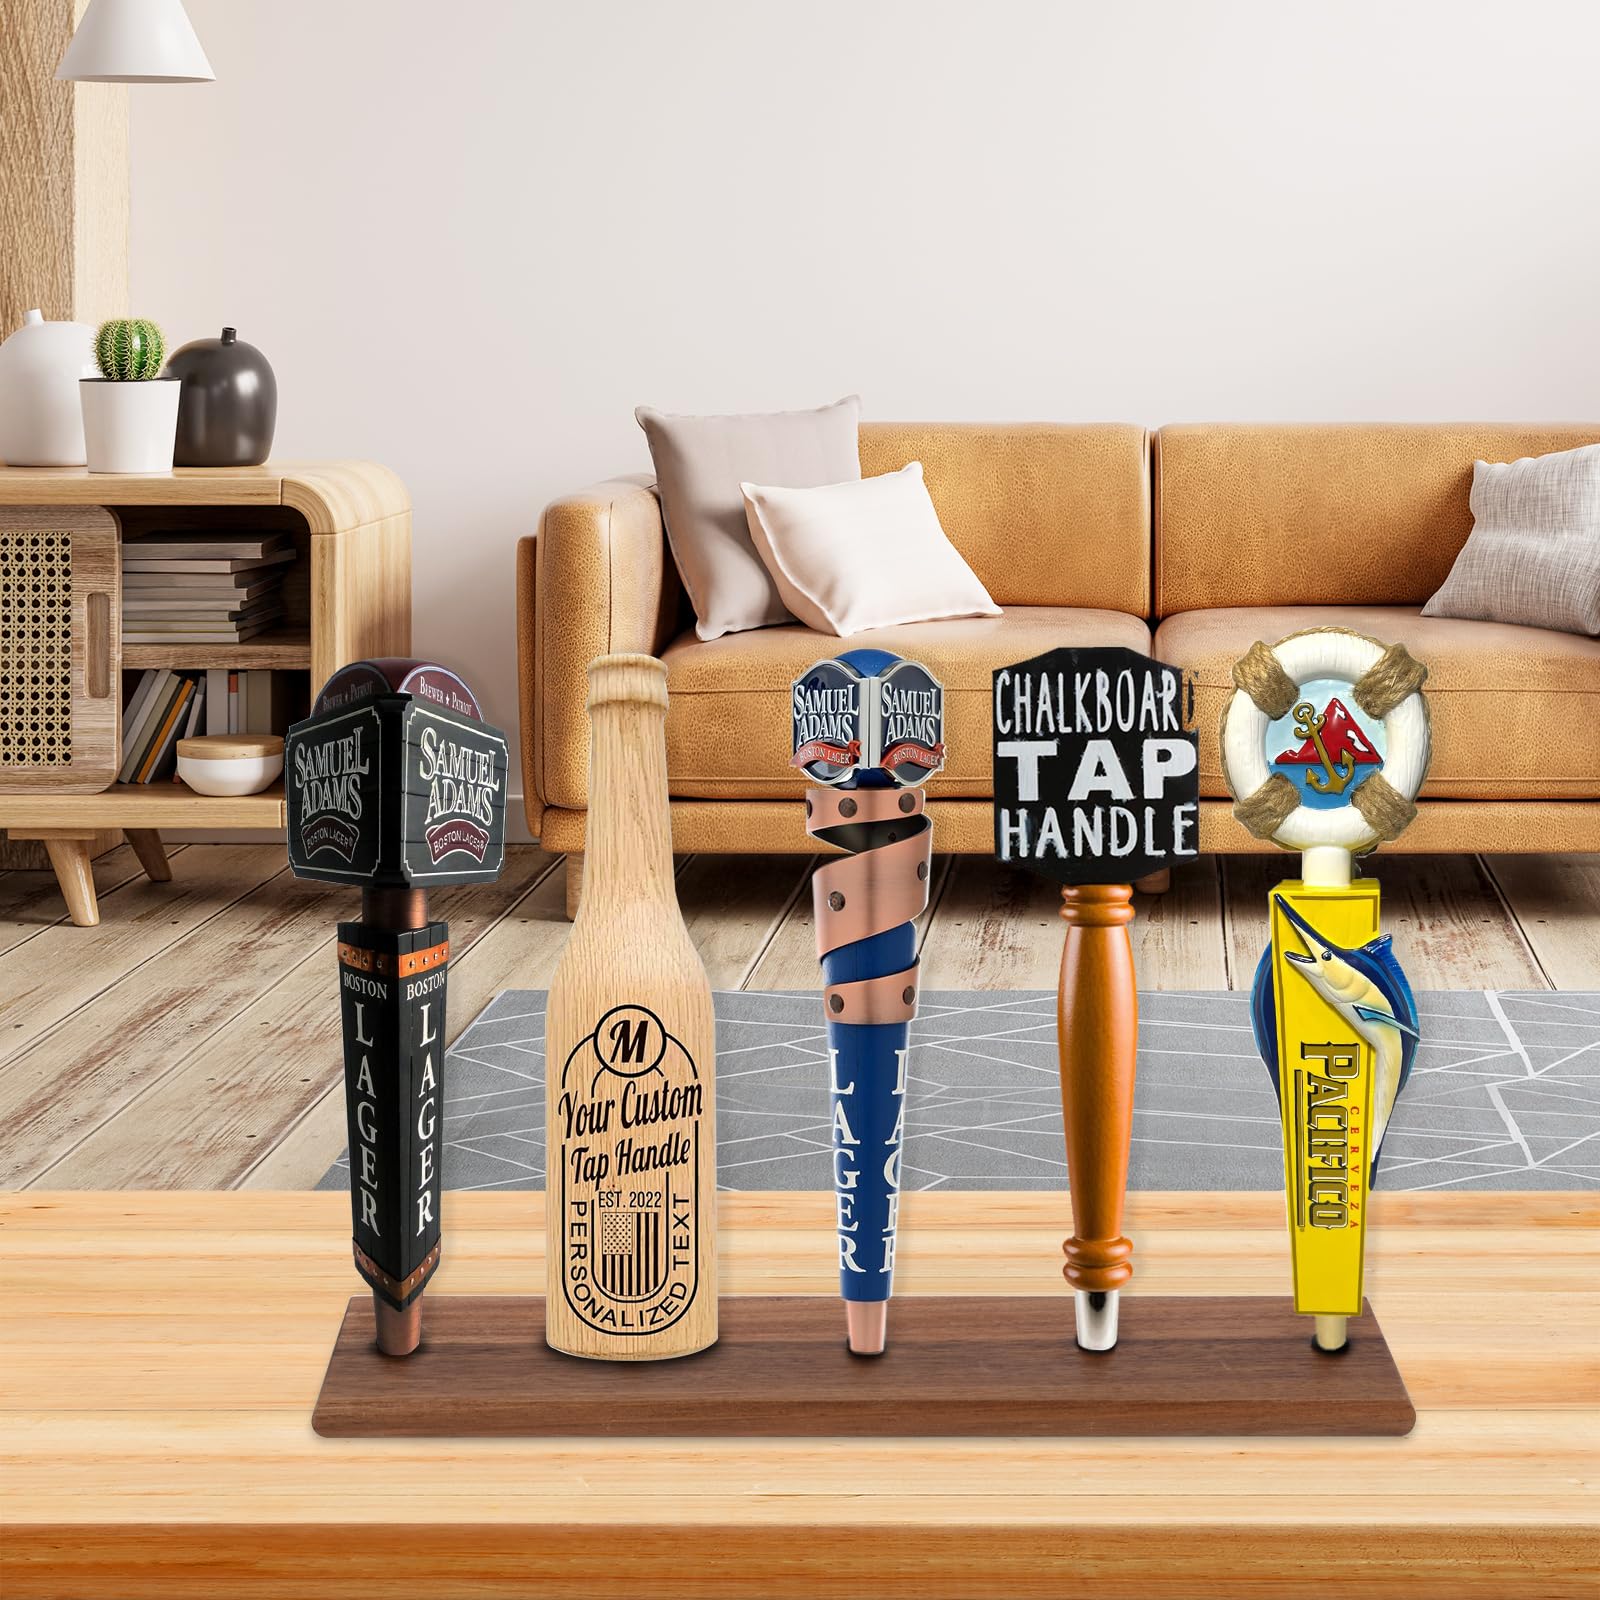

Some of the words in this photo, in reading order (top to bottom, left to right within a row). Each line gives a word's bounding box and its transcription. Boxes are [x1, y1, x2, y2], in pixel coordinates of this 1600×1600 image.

[420, 676, 443, 704] BREWER
[452, 691, 472, 716] PATRIOT
[793, 684, 859, 720] SAMUEL
[881, 682, 941, 720] SAMUEL
[295, 726, 370, 789] SAMUEL
[797, 714, 854, 750] ADAMS
[800, 745, 825, 762] BOSTON
[885, 716, 936, 748] ADAMS
[893, 747, 918, 764] BOSTON
[420, 727, 500, 792] SAMUEL
[997, 738, 1197, 802] TAP
[300, 774, 362, 826] ADAMS
[424, 776, 493, 826] ADAMS
[433, 830, 461, 854] BOSTON
[999, 803, 1198, 861] HANDLE
[343, 971, 387, 1000] BOSTON
[406, 969, 445, 1001] BOSTON
[609, 1019, 649, 1064] M
[354, 1001, 381, 1237] LAGER
[416, 1002, 438, 1237] LAGER
[558, 1090, 615, 1139] Your
[621, 1080, 703, 1129] Custom
[828, 1048, 867, 1273] LAGER
[1300, 1041, 1361, 1230] PACIFICO
[570, 1146, 609, 1192] Tap
[615, 1131, 691, 1177] Handle
[1350, 1106, 1360, 1229] CERVEZA
[599, 1191, 627, 1208] EST.
[629, 1191, 662, 1208] 2022
[570, 1201, 688, 1327] PERSONALIZED
[672, 1193, 690, 1271] TEXT
